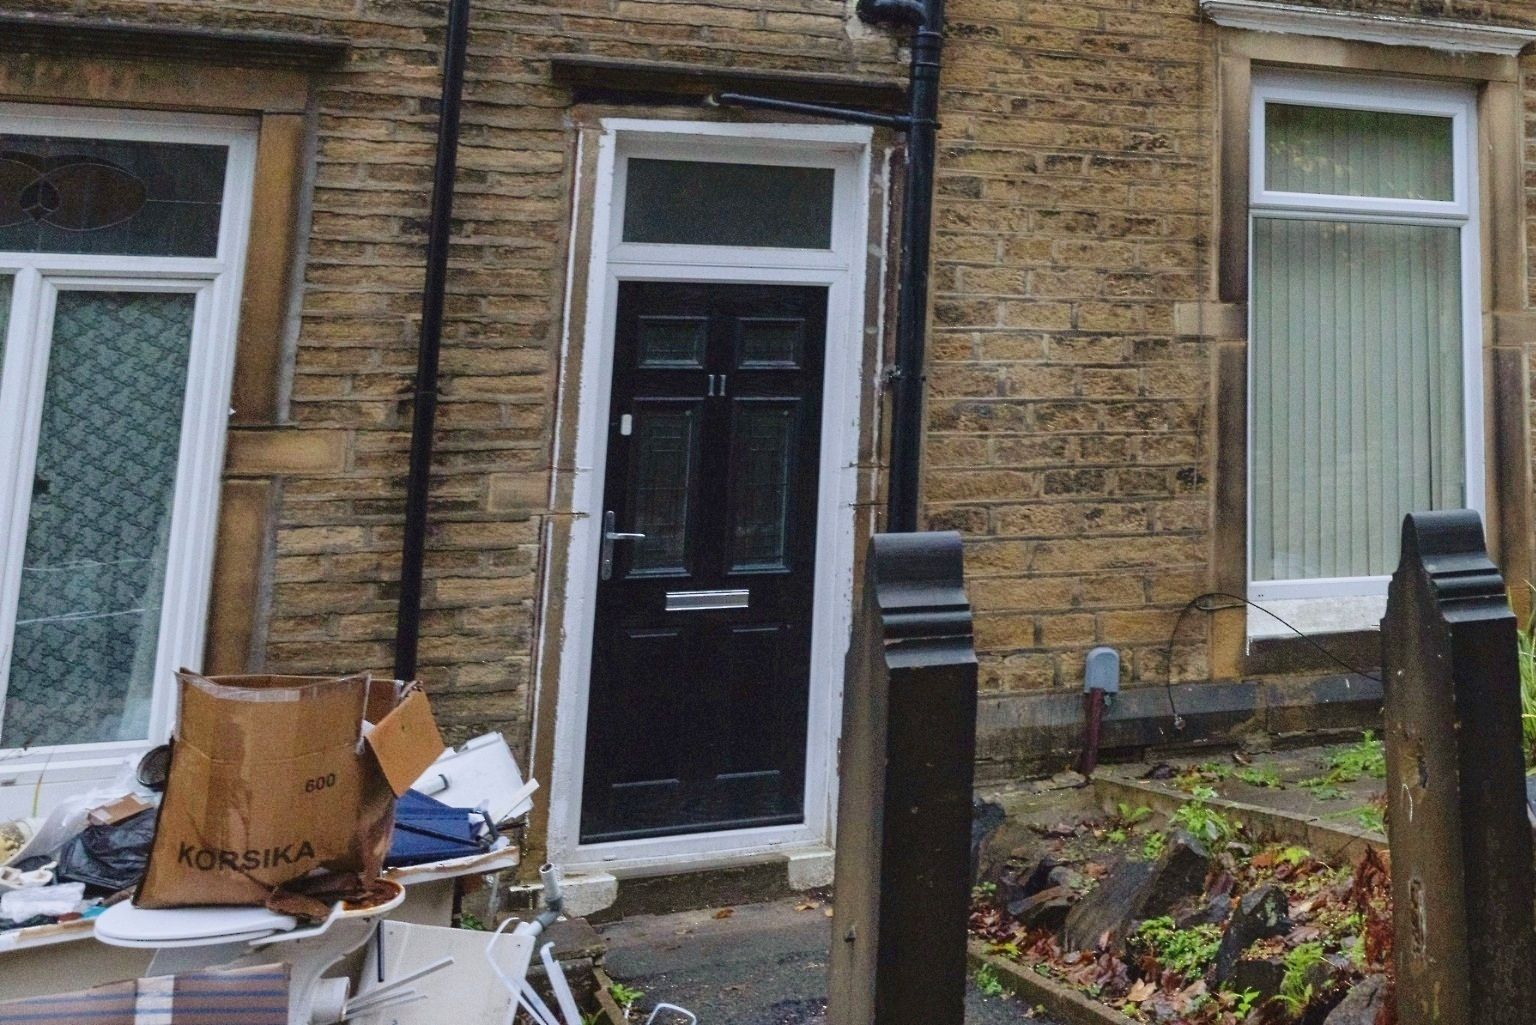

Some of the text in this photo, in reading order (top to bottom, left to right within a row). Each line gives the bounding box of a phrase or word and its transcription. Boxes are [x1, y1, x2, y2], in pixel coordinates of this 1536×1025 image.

[708, 374, 727, 396] 11
[305, 773, 336, 793] 600
[178, 841, 315, 871] KORSIKA
